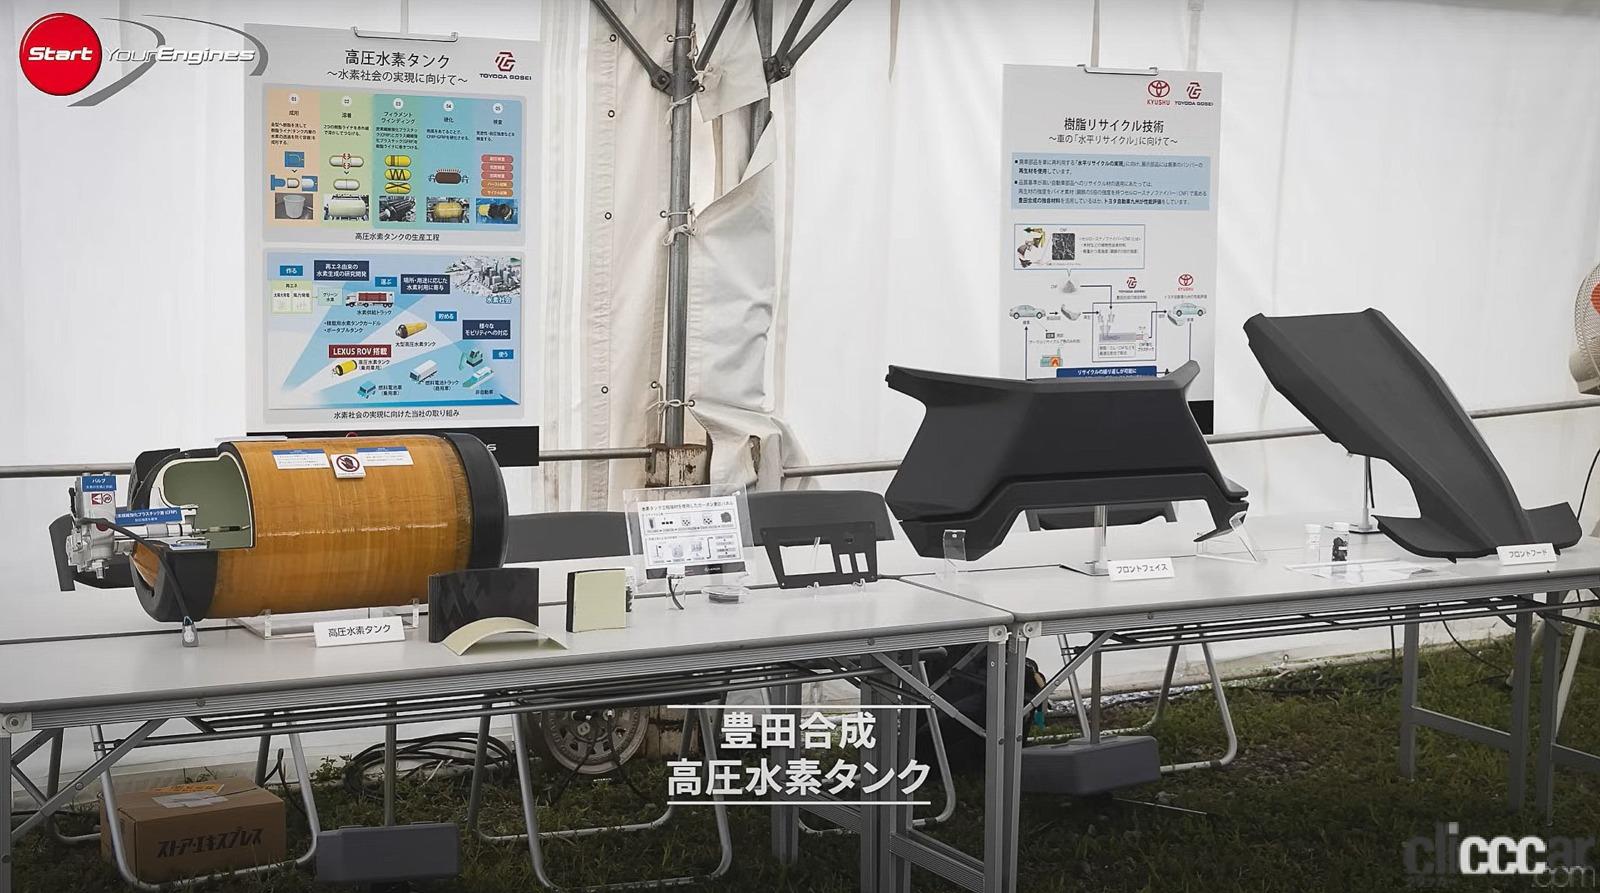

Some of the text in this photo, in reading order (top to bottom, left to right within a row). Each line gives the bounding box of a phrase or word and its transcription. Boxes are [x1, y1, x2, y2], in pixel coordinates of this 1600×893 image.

[345, 49, 451, 70] 高圧水素タンク
[1064, 117, 1164, 133] 樹脂リサイクル技術
[355, 232, 440, 241] 高圧水素タンクの生産工程
[334, 410, 460, 419] 水素社会の実現に向けた当社の取り組み
[1509, 550, 1547, 558] フロントフード
[1116, 564, 1168, 573] フロントフェイス
[328, 624, 390, 637] 高圧水素タンク
